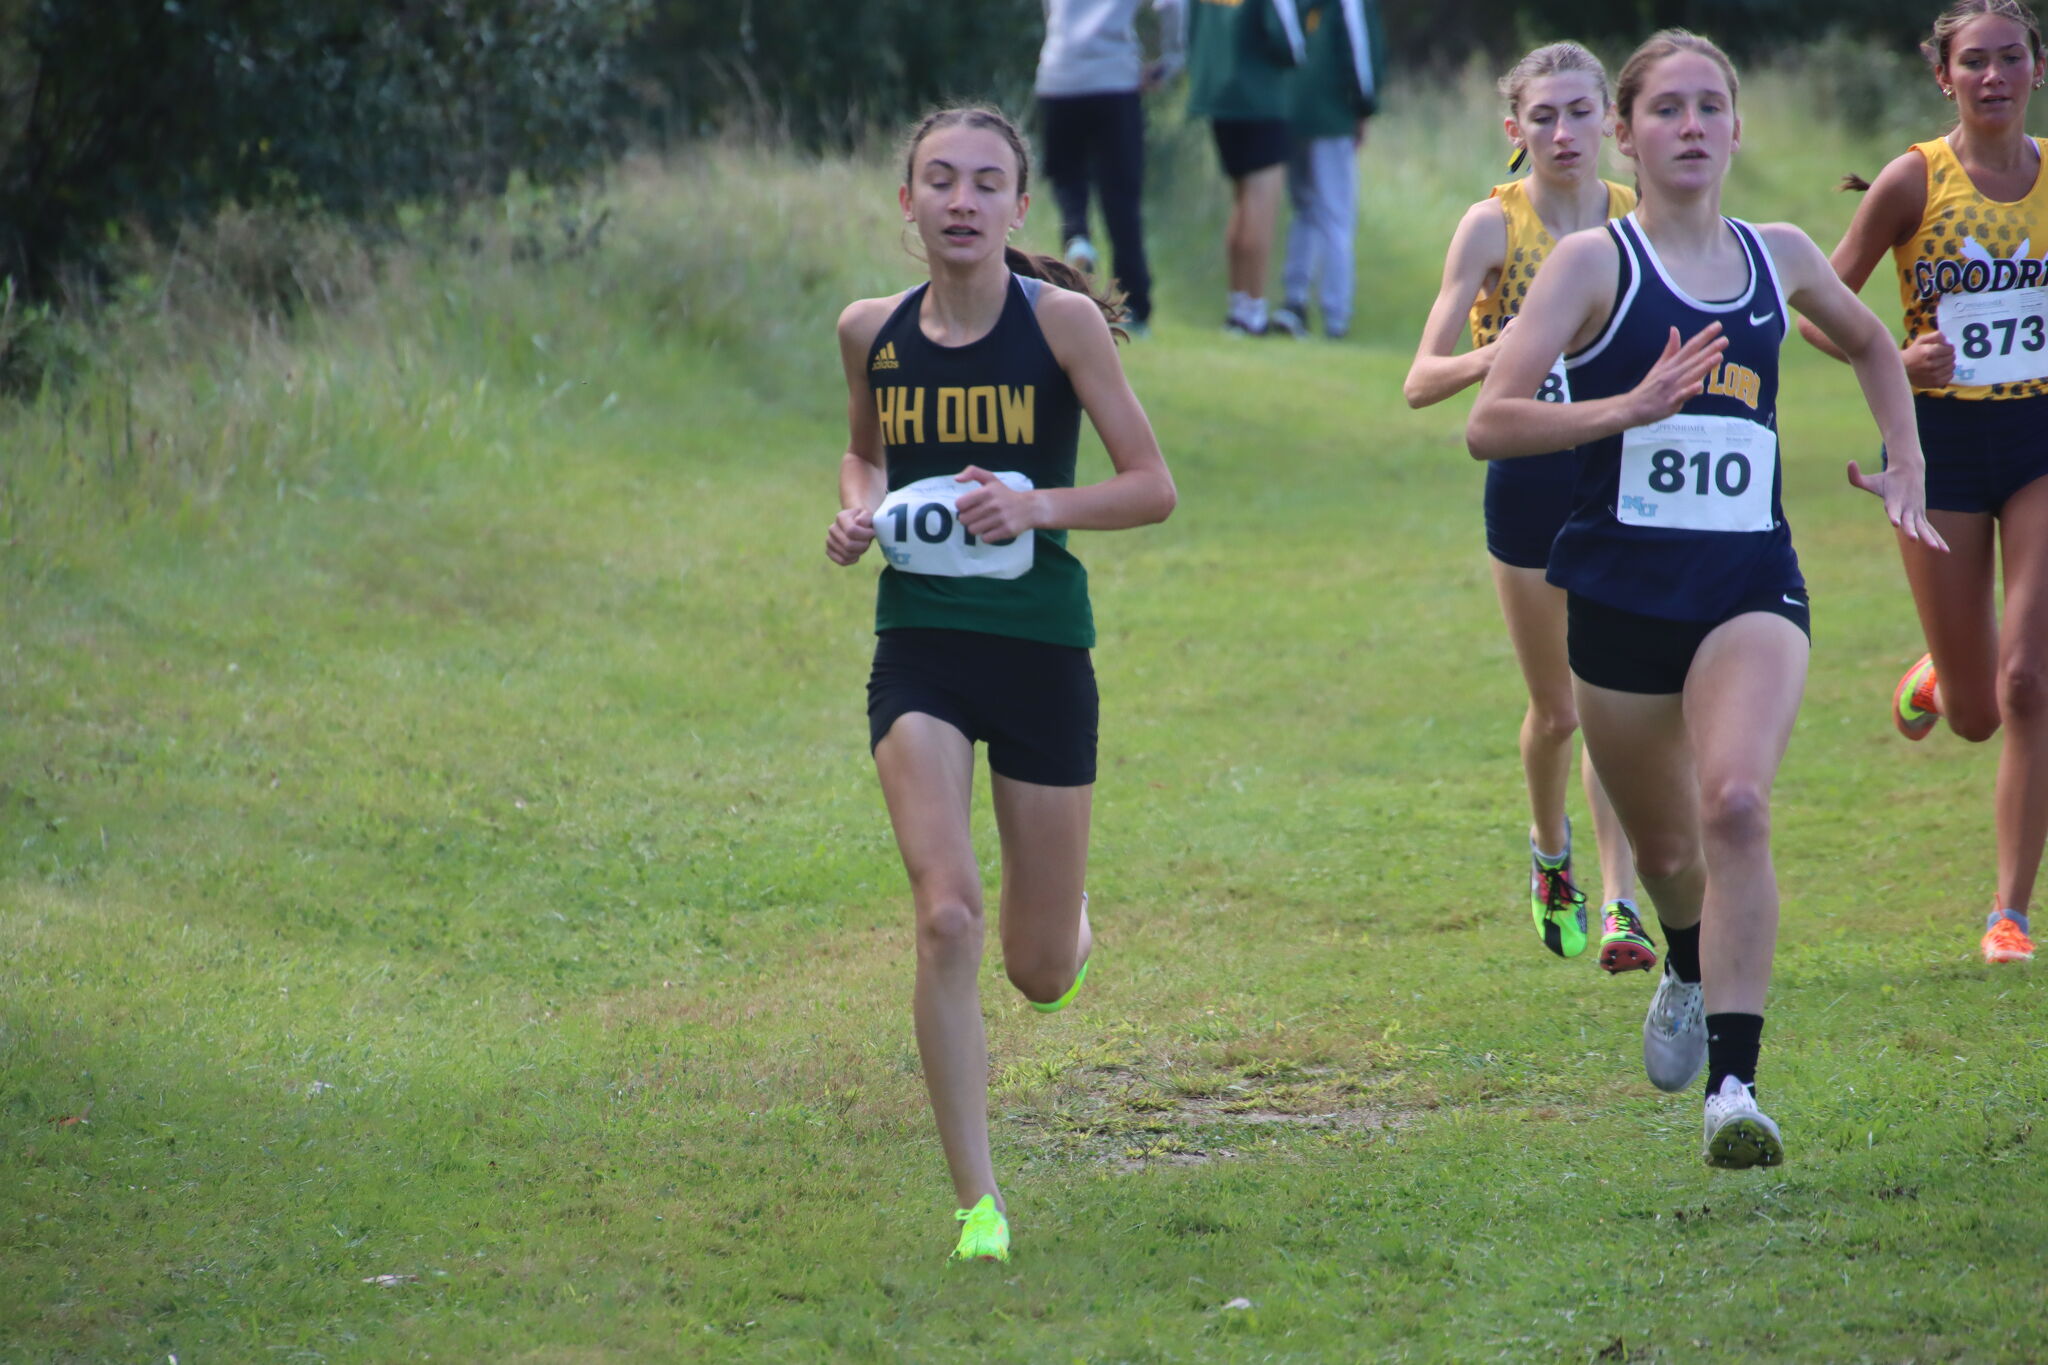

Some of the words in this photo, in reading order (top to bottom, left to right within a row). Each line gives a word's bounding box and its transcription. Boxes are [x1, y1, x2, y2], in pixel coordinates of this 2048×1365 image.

[1962, 314, 2045, 359] 873
[876, 386, 925, 446] HH
[937, 385, 1034, 444] DOW
[1648, 449, 1751, 496] 810
